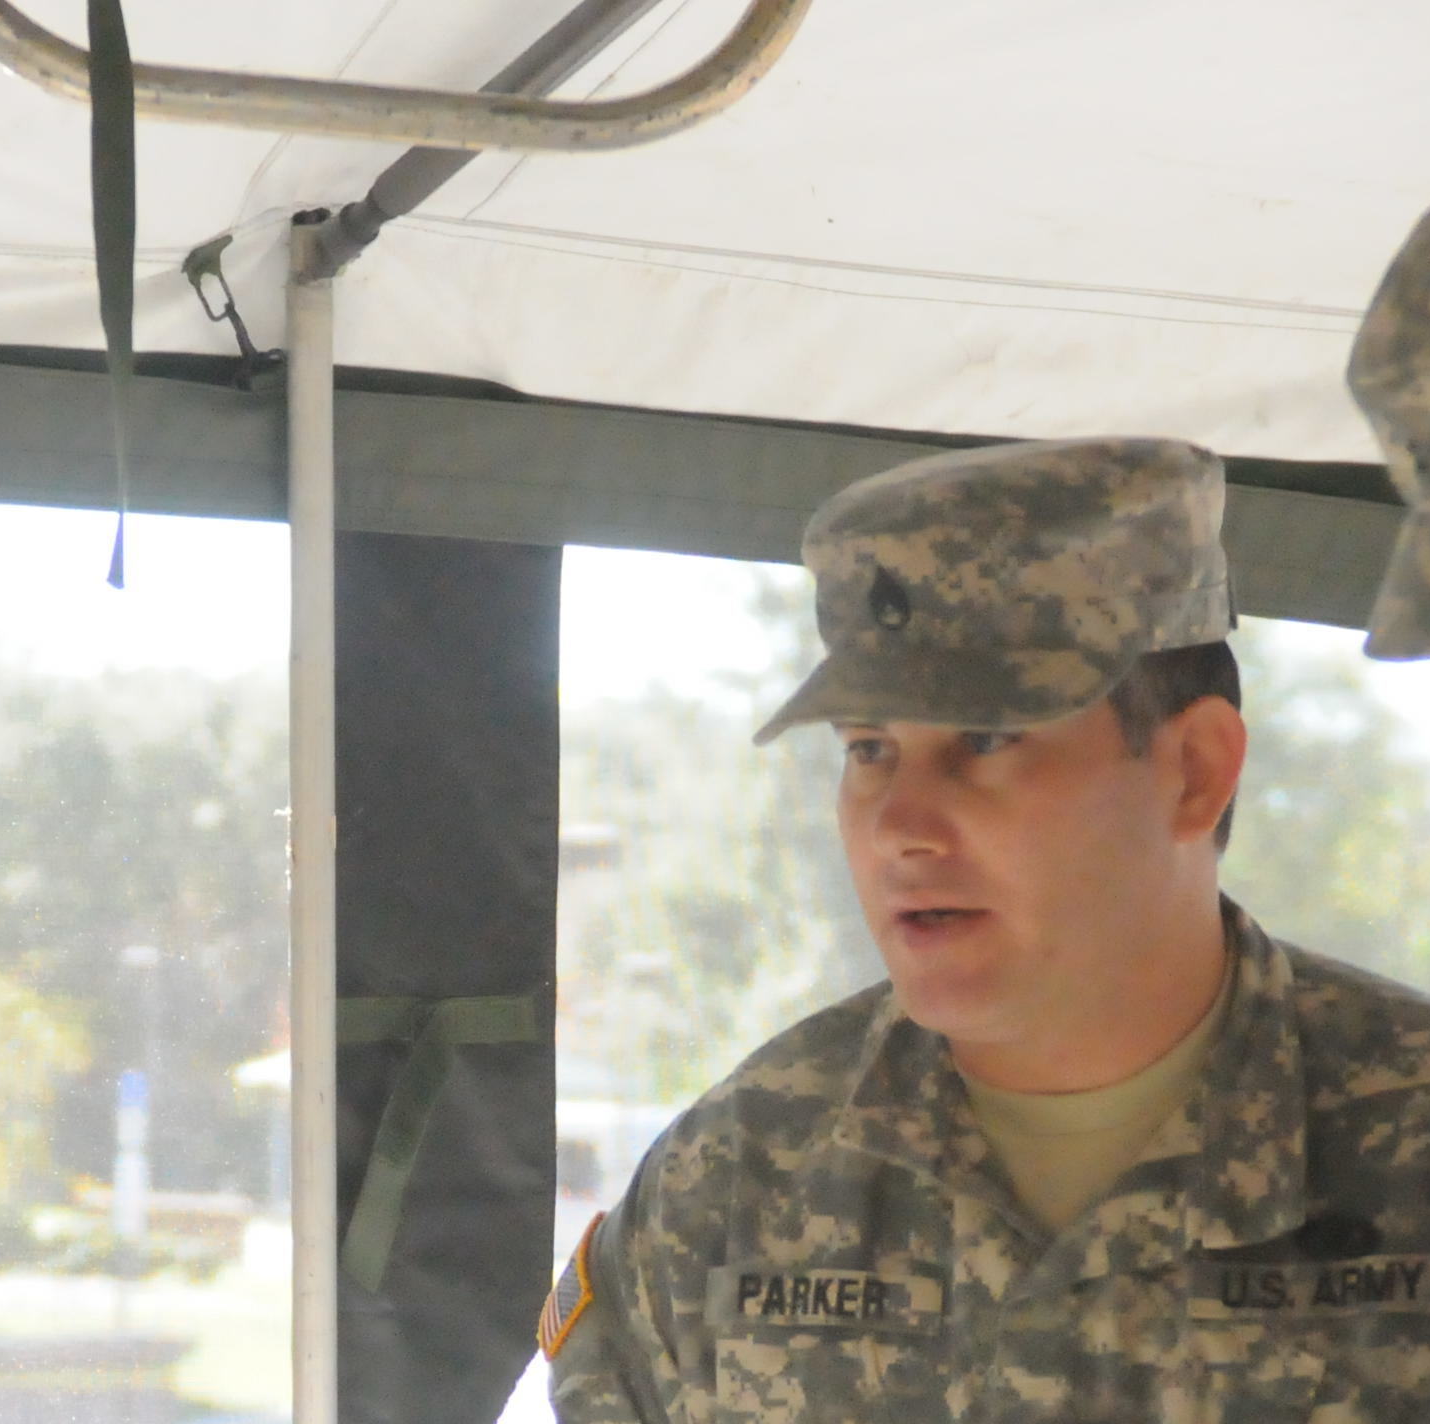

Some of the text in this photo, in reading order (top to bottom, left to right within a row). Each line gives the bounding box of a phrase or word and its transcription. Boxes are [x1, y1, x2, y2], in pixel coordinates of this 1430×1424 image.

[738, 1272, 887, 1319] PARKER
[1222, 1261, 1426, 1309] U.S. ARMY
